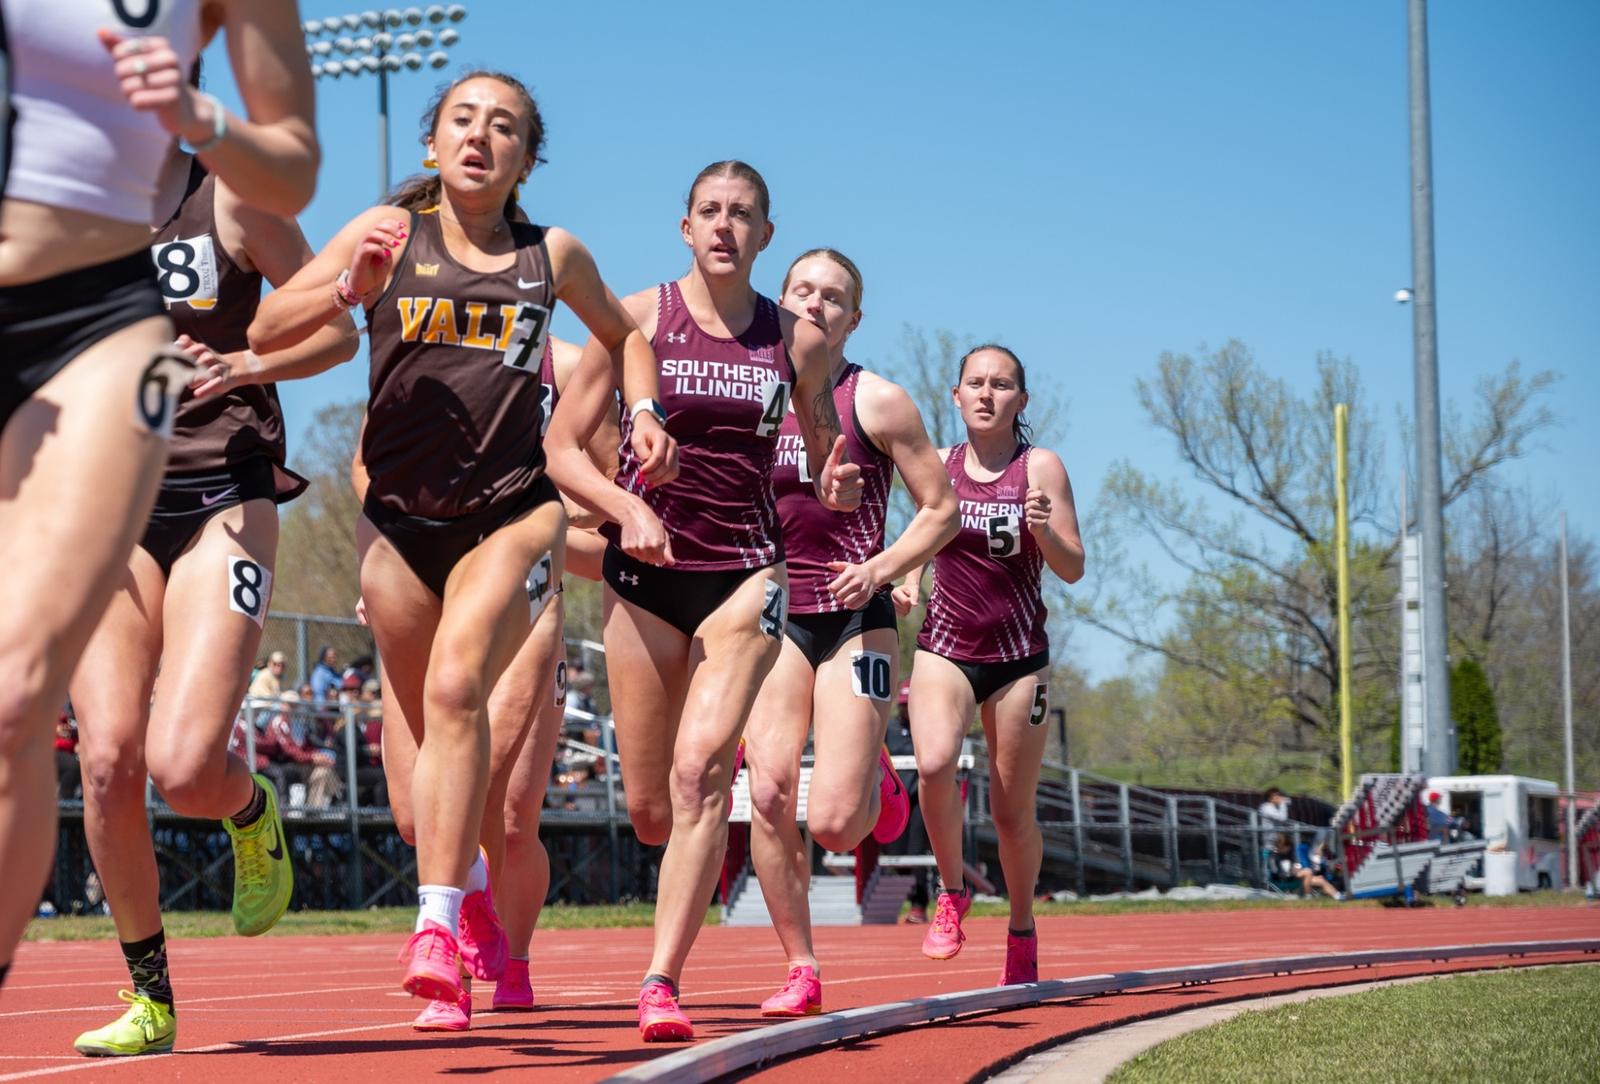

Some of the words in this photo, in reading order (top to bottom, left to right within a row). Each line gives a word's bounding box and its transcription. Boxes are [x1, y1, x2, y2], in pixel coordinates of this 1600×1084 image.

[157, 242, 200, 298] 8
[513, 305, 548, 368] 7
[661, 359, 780, 383] SOUTHERN
[761, 383, 785, 437] 4
[989, 515, 1015, 556] 5
[233, 559, 263, 617] 8
[761, 586, 784, 641] 4
[556, 661, 567, 706] 9
[852, 655, 891, 699] 10
[1029, 684, 1048, 725] 5
